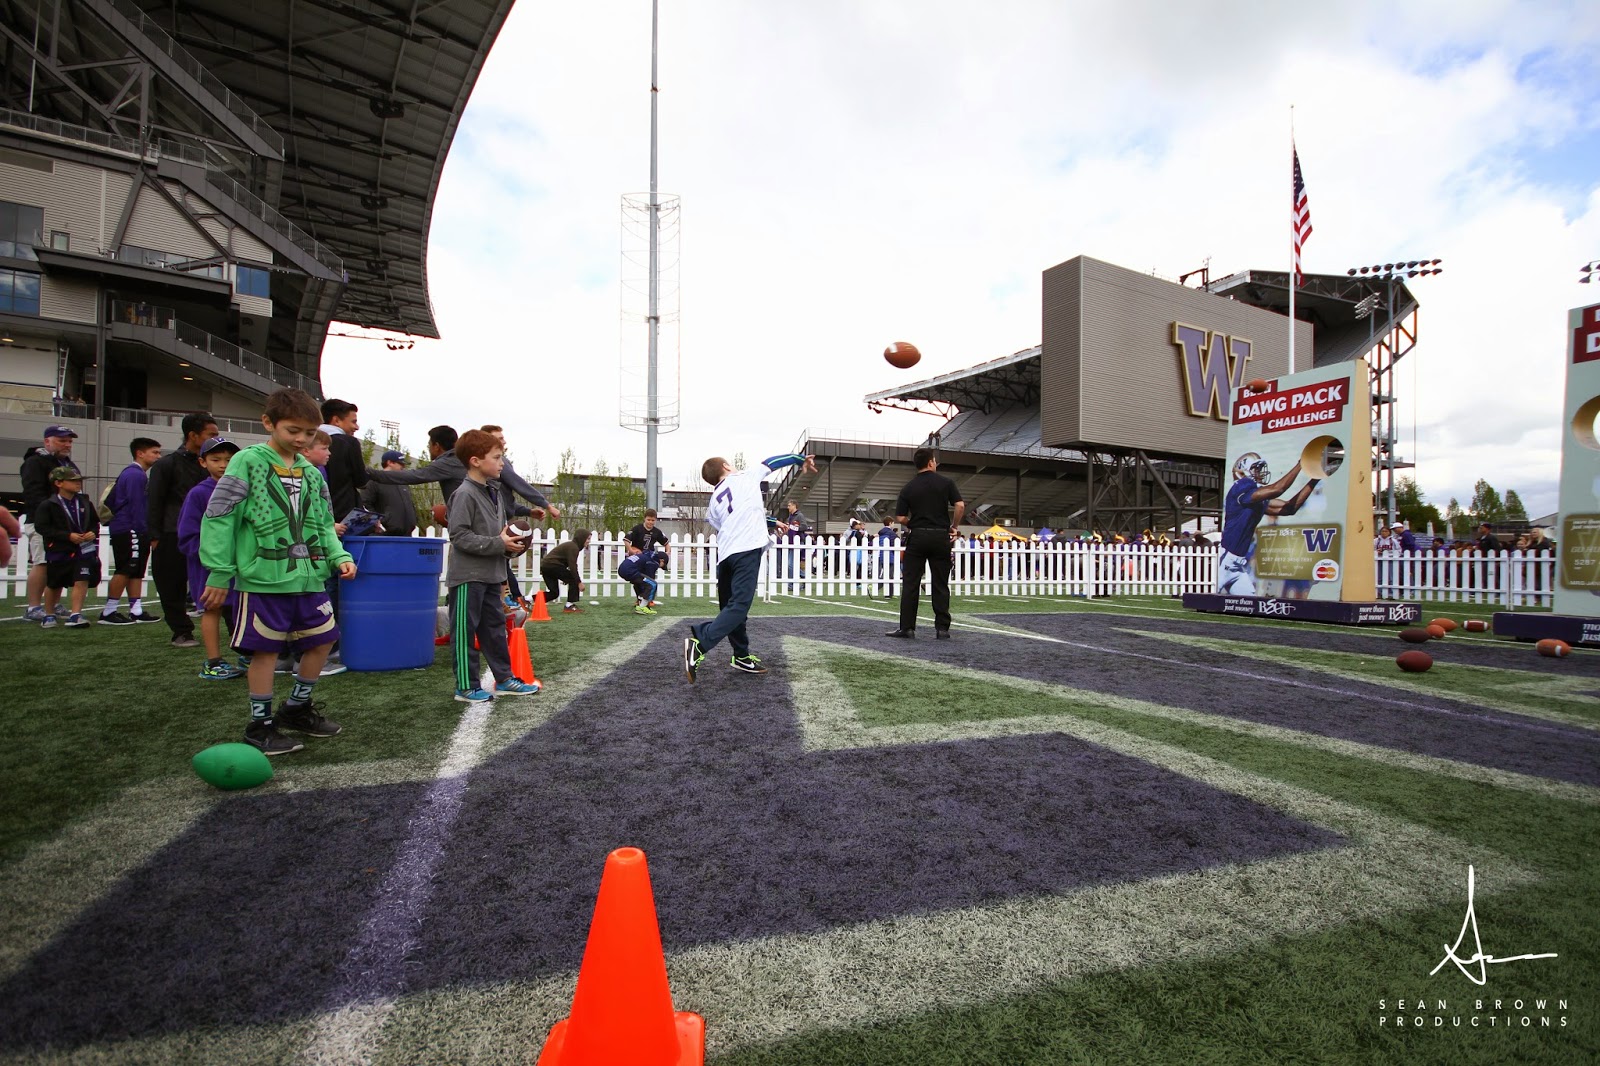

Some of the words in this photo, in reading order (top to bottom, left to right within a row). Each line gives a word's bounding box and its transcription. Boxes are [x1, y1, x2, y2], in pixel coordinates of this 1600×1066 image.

[1171, 320, 1253, 421] W
[1239, 397, 1287, 419] DAWG
[1291, 385, 1342, 409] PACK
[1267, 408, 1336, 430] CHALLENGE
[716, 487, 733, 514] 7
[1302, 528, 1337, 553] W
[1223, 605, 1235, 613] just
[1235, 606, 1255, 614] money
[1240, 598, 1254, 606] than
[1258, 599, 1297, 616] BECU
[1357, 613, 1368, 622] just
[1368, 614, 1386, 623] money
[1389, 604, 1418, 622] BECU
[1583, 623, 1600, 631] mo
[293, 683, 312, 698] 12
